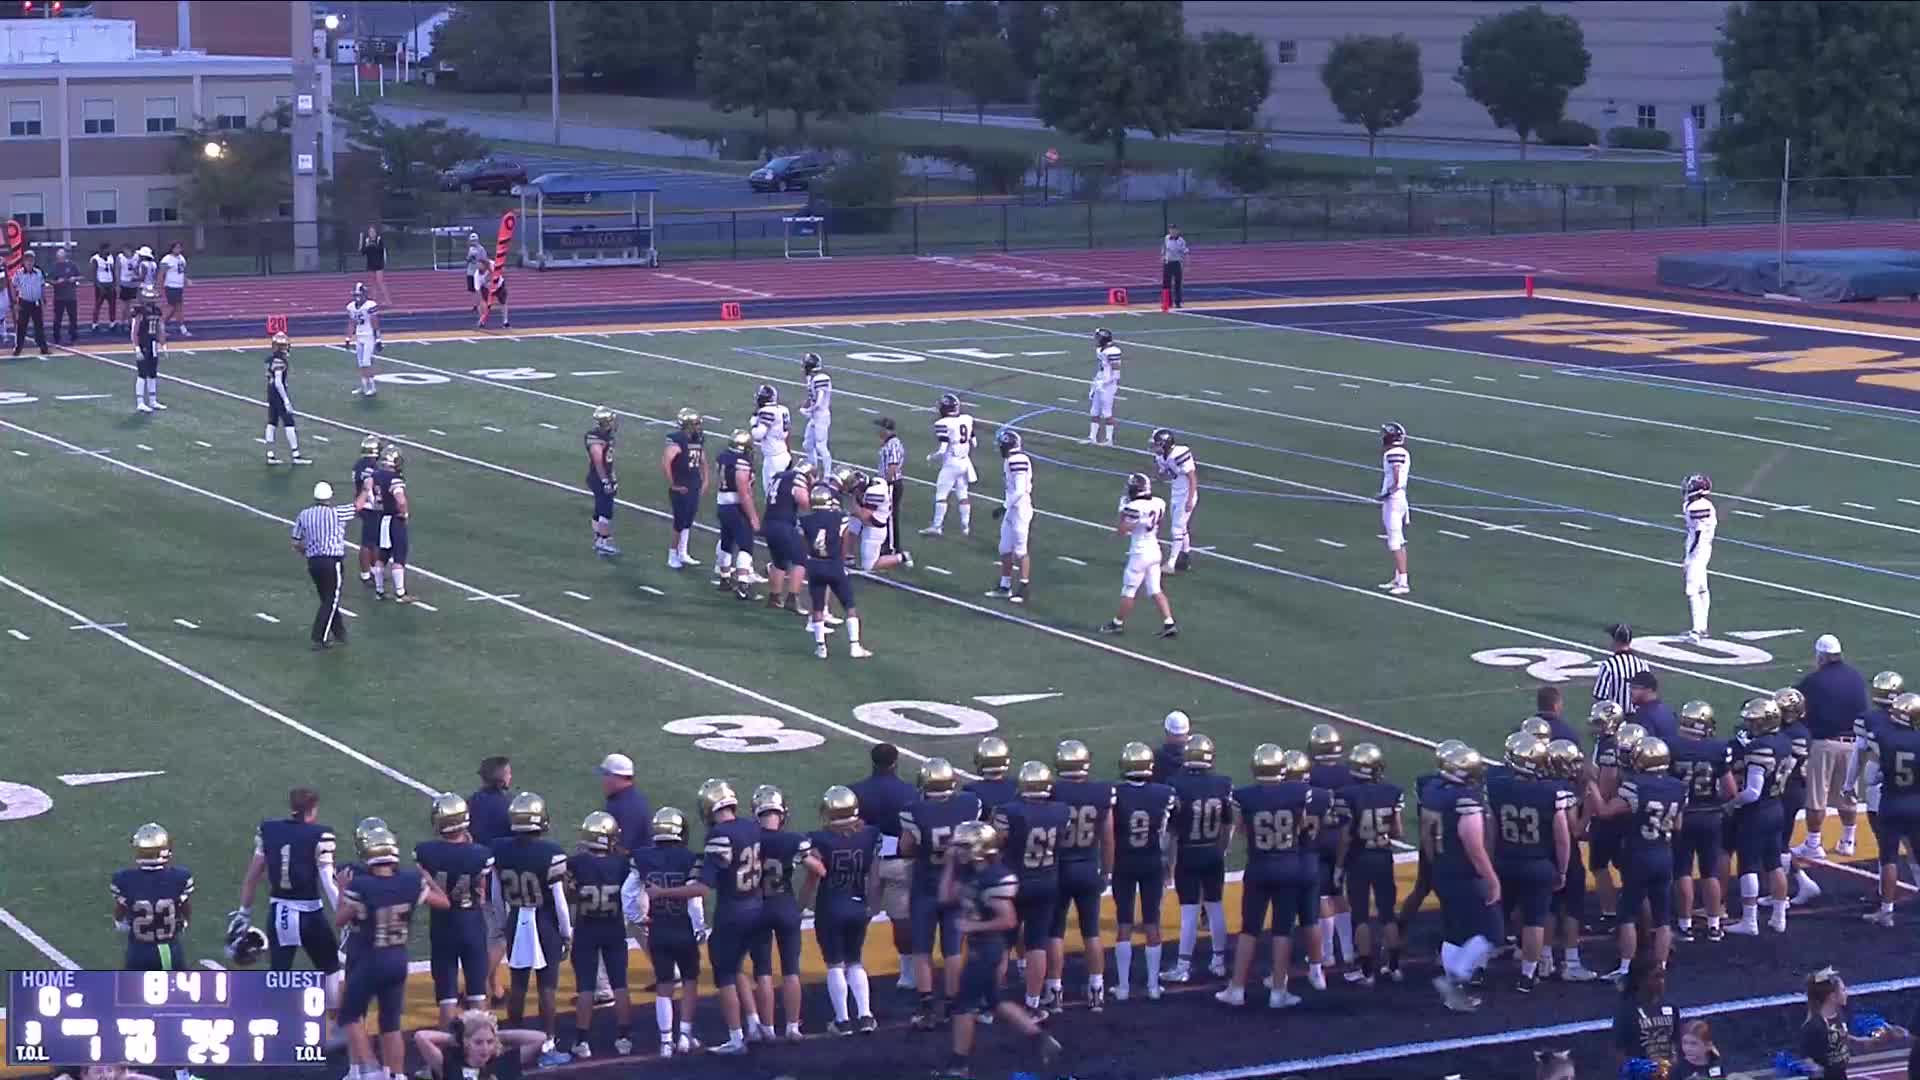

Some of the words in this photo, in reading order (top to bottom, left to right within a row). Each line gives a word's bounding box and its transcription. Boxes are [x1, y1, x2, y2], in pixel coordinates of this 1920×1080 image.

[269, 318, 287, 332] 20
[724, 304, 739, 317] 10
[959, 424, 969, 444] 9
[814, 528, 828, 556] 4
[1129, 810, 1150, 848] 9
[1189, 798, 1222, 841] 10
[1253, 809, 1293, 850] 68
[1359, 807, 1393, 848] 45
[1500, 804, 1540, 844] 63
[1640, 800, 1679, 841] 34
[279, 844, 292, 889] 1
[1023, 827, 1057, 868] 61
[831, 848, 864, 888] 51
[500, 869, 543, 908] 20
[132, 898, 177, 942] 23
